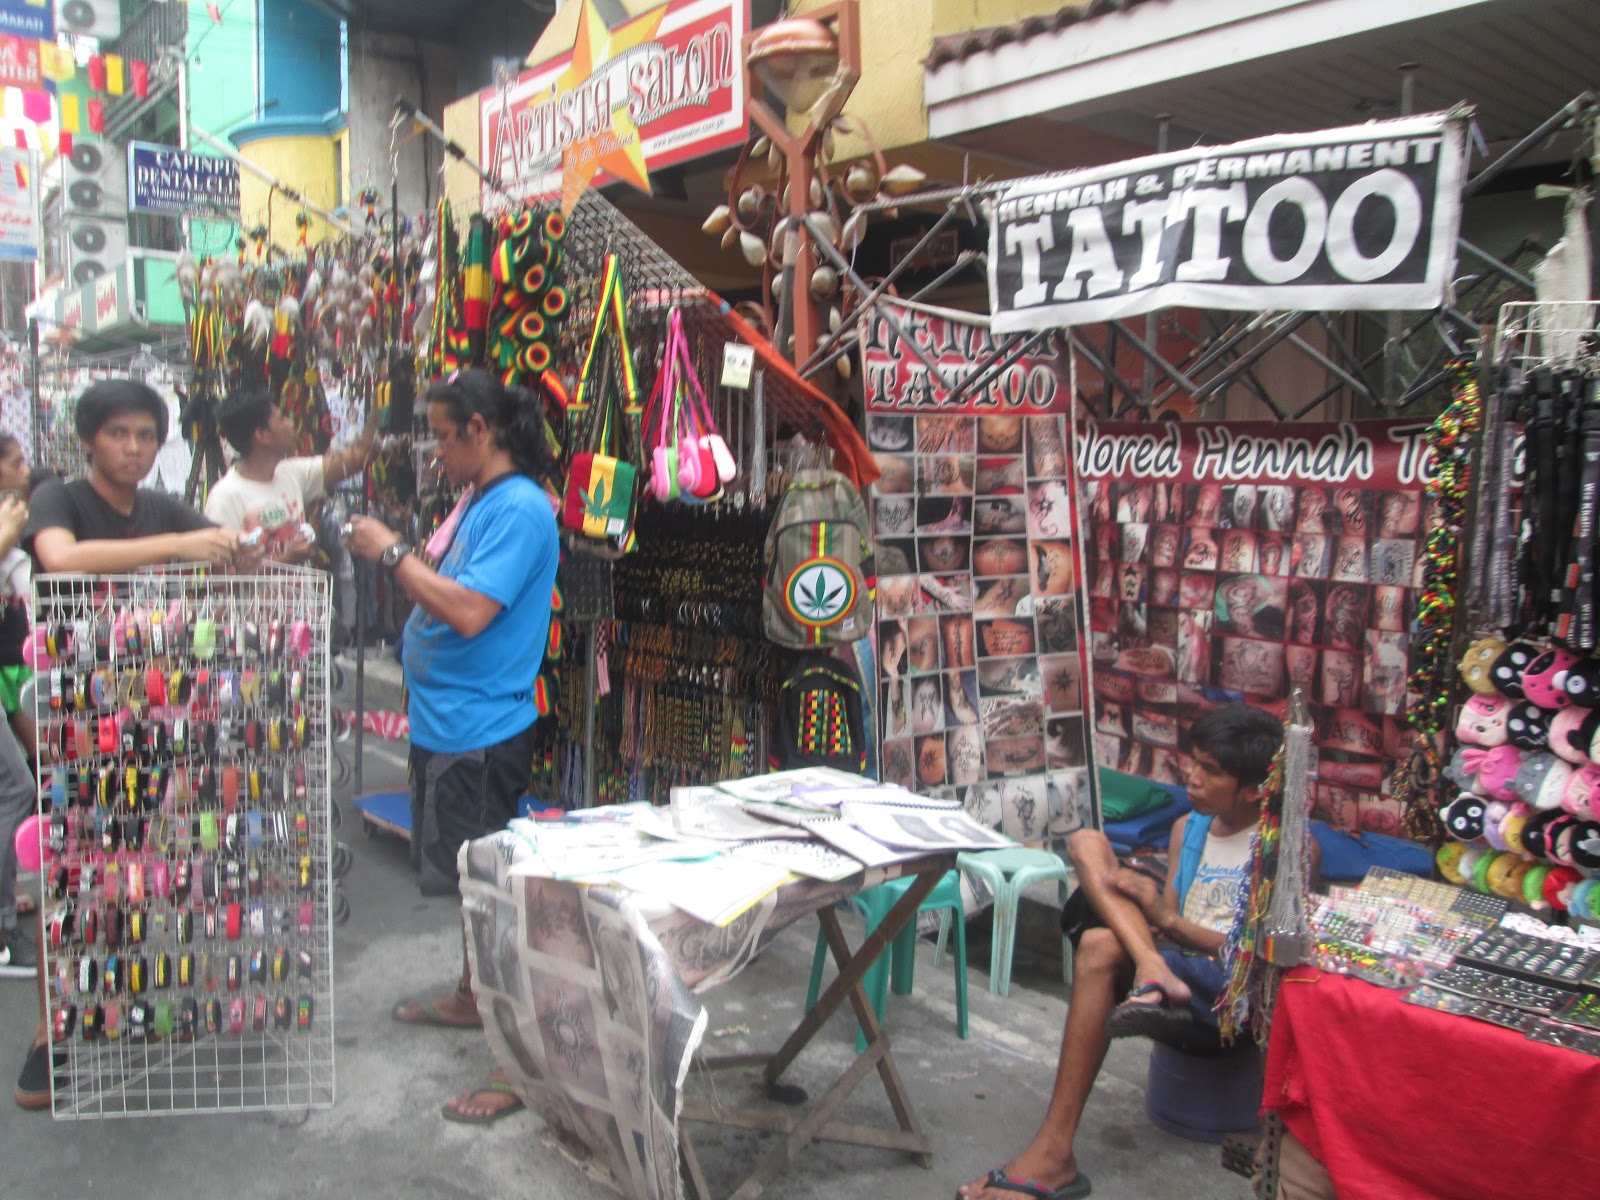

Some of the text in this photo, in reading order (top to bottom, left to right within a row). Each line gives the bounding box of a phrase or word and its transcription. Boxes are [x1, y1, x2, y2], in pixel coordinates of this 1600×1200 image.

[138, 165, 203, 192] DENTAL
[999, 136, 1443, 221] HENNAH & PERMANENT
[1005, 168, 1423, 309] TATTOO
[866, 360, 1058, 410] TATTOO
[1076, 421, 1182, 478] lored
[1193, 423, 1374, 482] Hennah
